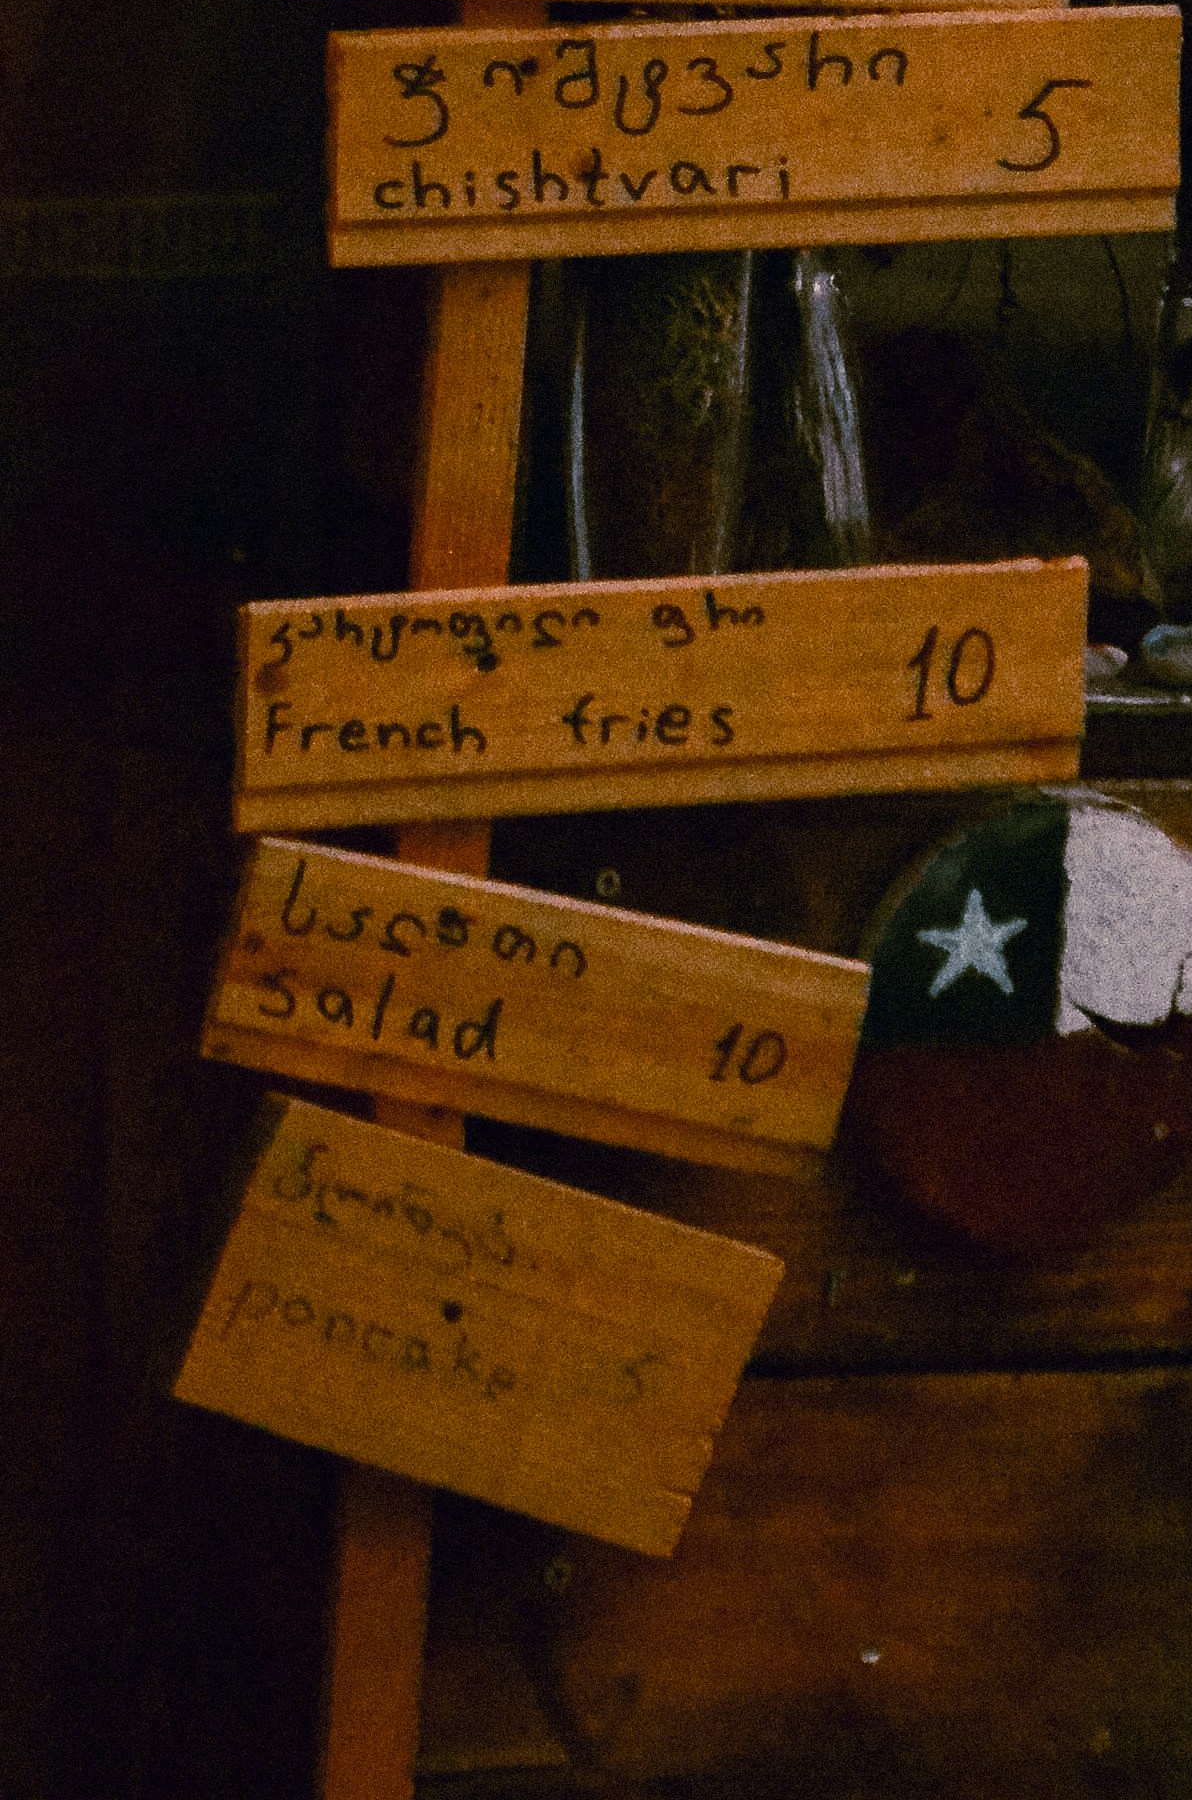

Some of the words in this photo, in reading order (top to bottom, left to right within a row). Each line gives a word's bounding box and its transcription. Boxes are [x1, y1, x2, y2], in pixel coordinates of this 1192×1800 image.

[997, 80, 1093, 172] 5
[373, 148, 792, 211] chishtvari
[905, 625, 995, 721] 10
[264, 702, 489, 756] French
[563, 694, 734, 748] fries
[710, 1022, 789, 1086] 10
